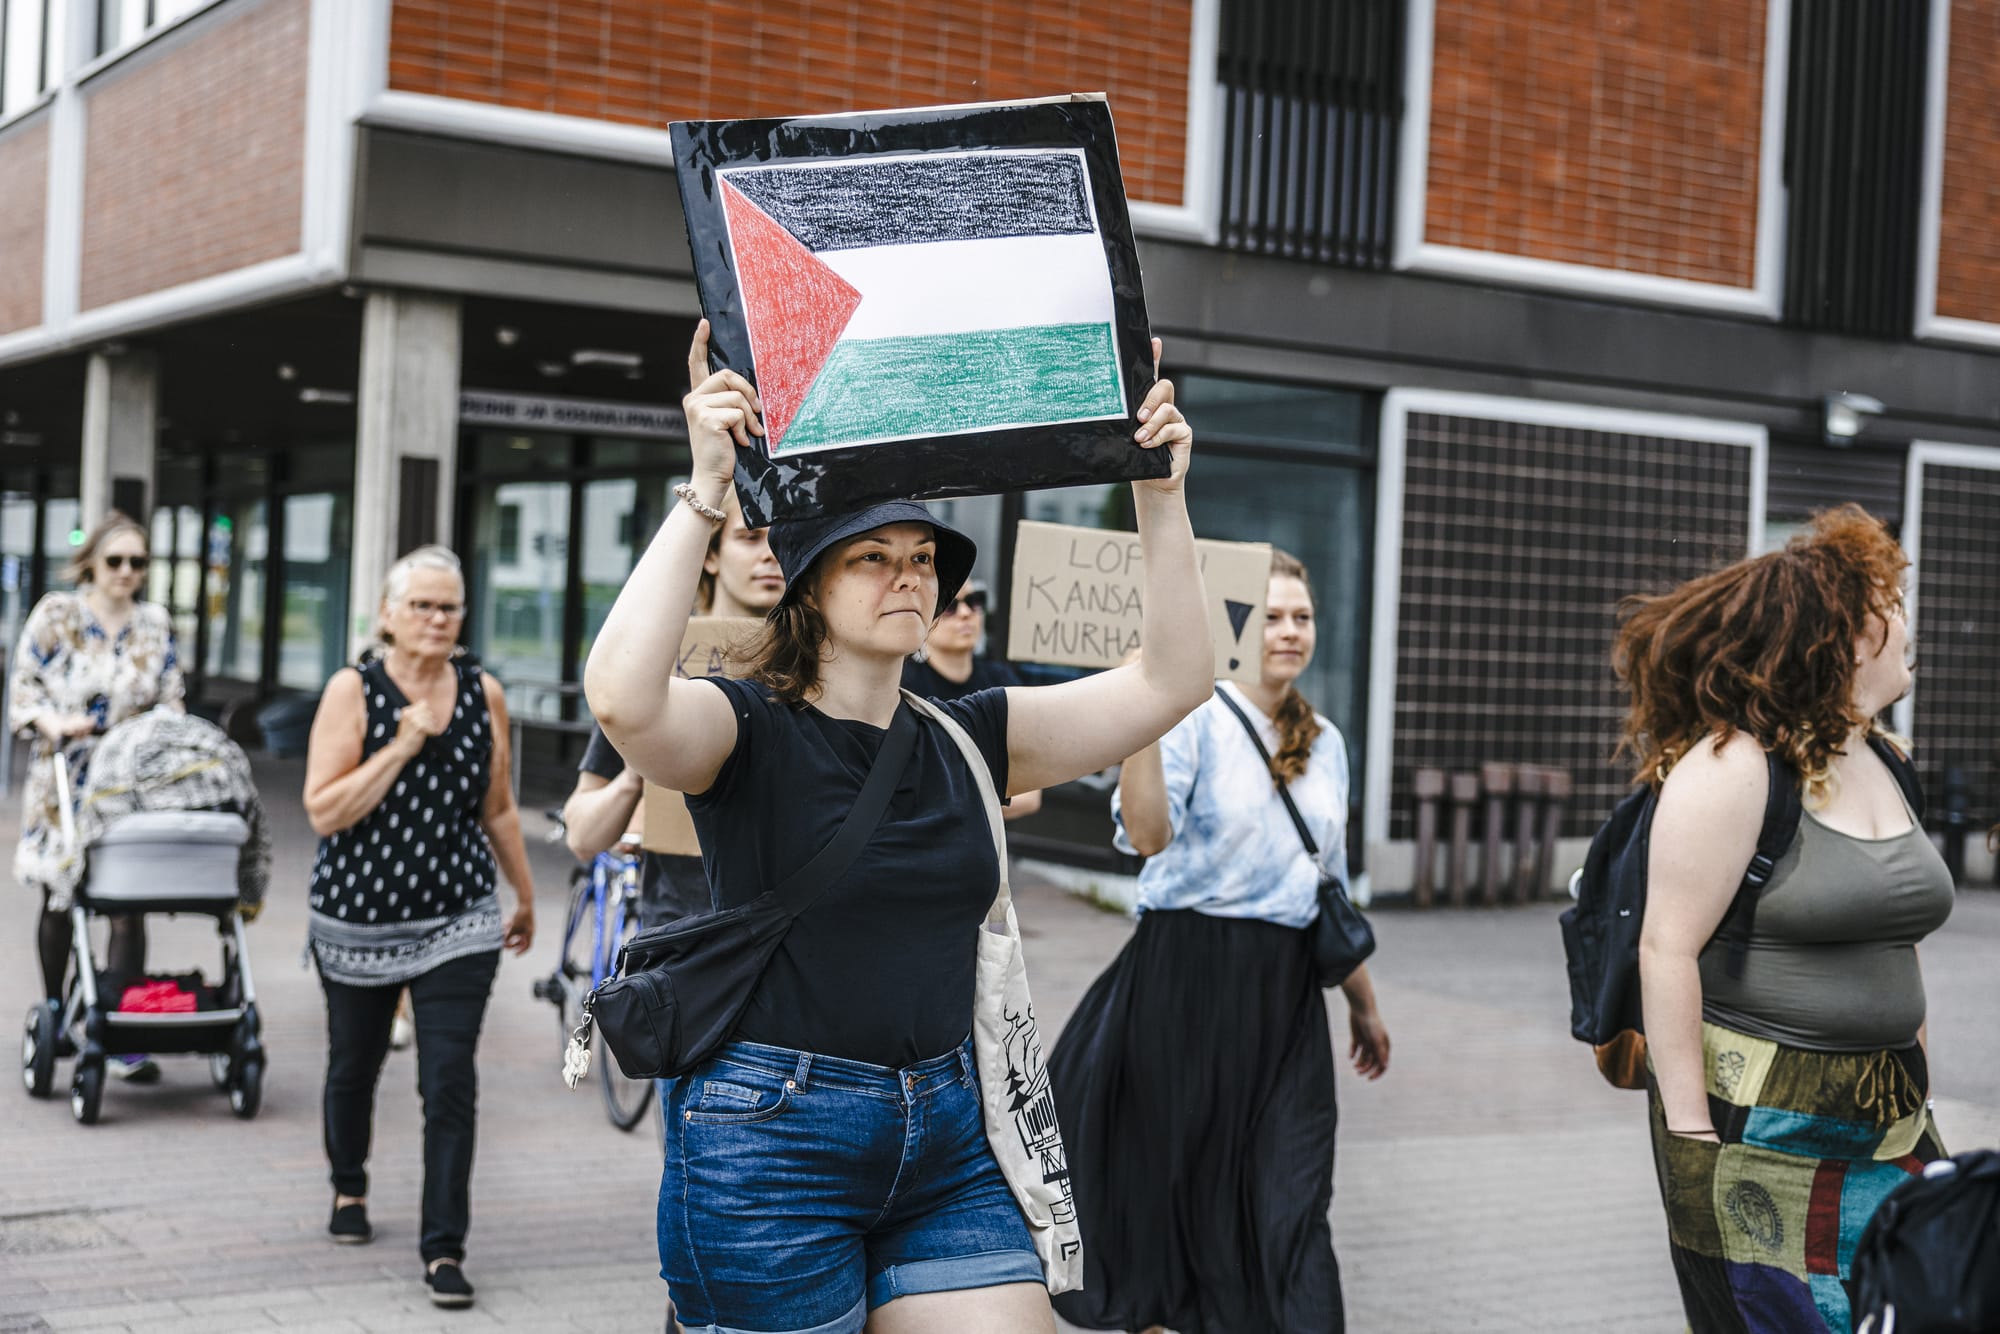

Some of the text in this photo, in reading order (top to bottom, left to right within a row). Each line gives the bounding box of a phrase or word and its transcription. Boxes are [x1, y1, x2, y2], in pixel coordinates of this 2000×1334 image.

[1068, 539, 1207, 575] LOP
[1026, 576, 1144, 619] KANSA
[1031, 620, 1142, 659] MURHA
[675, 643, 723, 679] KA
